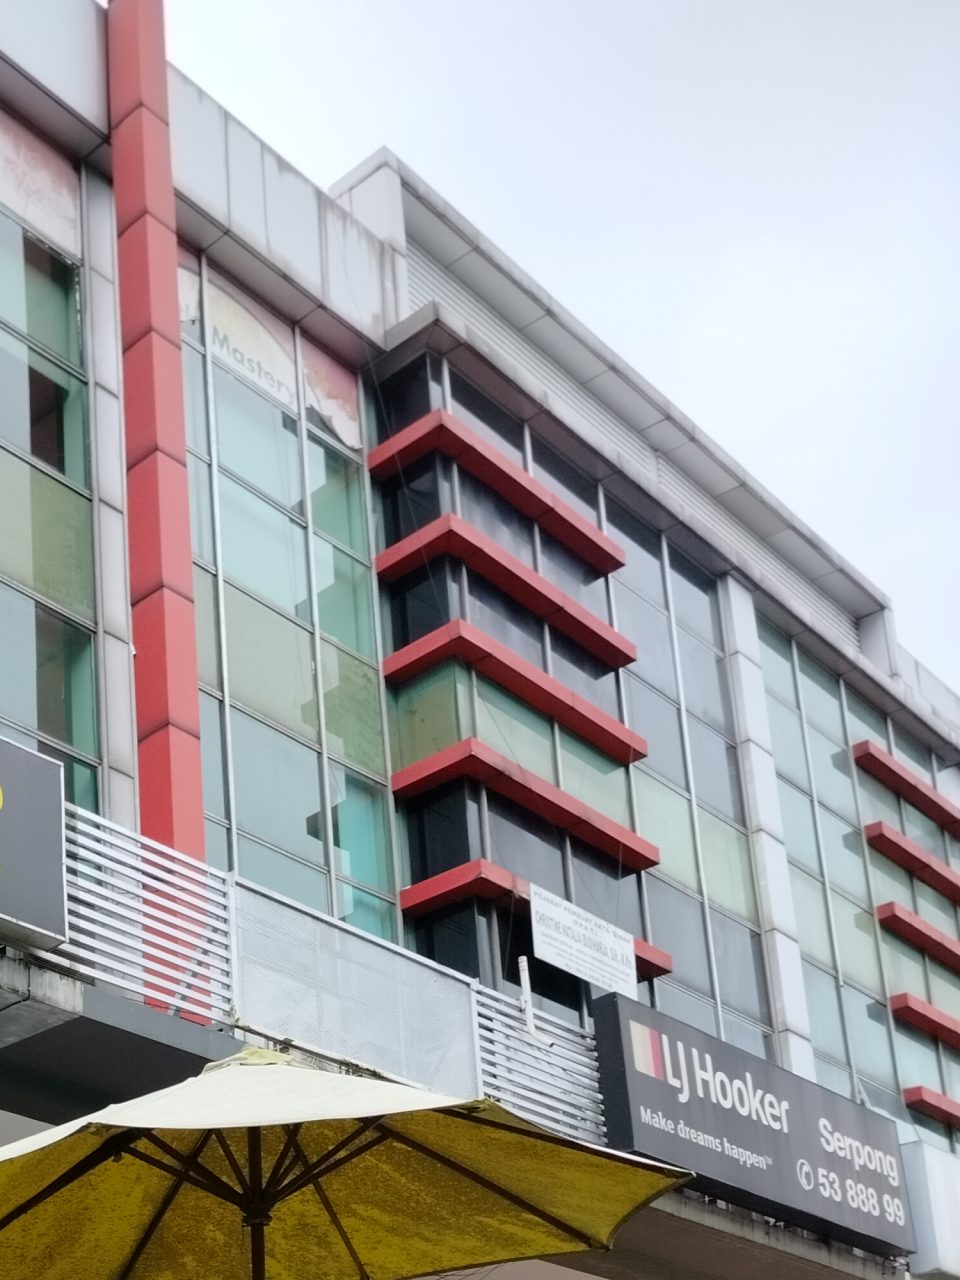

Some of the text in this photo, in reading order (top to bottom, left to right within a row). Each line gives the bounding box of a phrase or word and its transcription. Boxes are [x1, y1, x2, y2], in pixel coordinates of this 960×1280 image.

[640, 1105, 675, 1134] Make
[677, 1119, 723, 1152] dreams
[661, 1033, 900, 1187] LJ Hooker Serpong
[817, 1167, 905, 1227] 53 888 99
